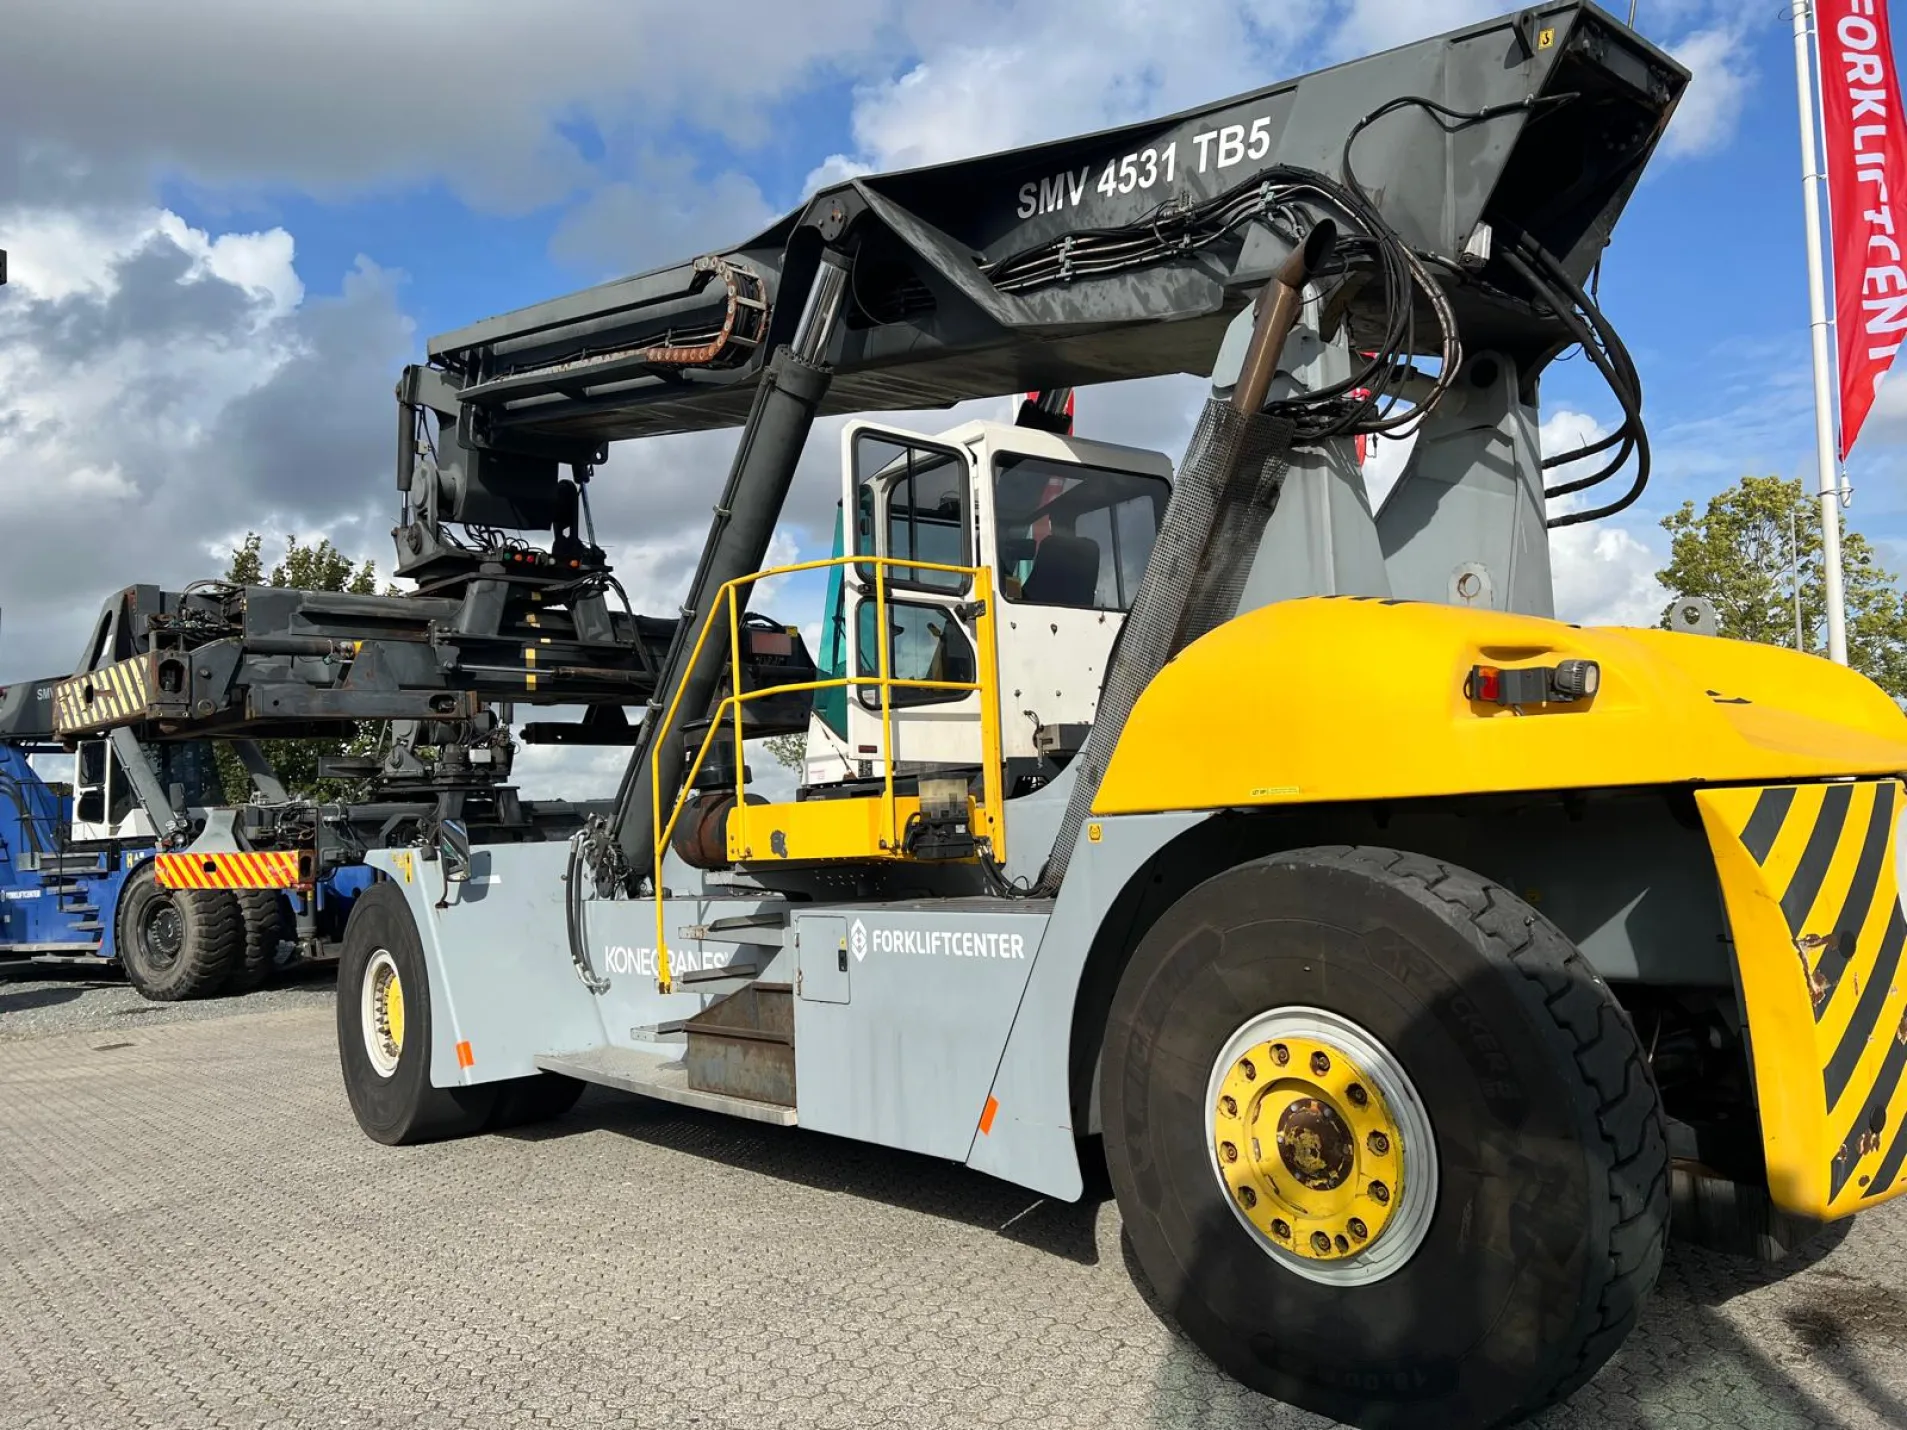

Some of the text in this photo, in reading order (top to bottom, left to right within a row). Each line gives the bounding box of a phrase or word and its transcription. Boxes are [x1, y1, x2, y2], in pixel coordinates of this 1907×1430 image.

[1017, 116, 1271, 219] SMV 4531 TB5
[873, 930, 1024, 959] FORKLIFTCENTER
